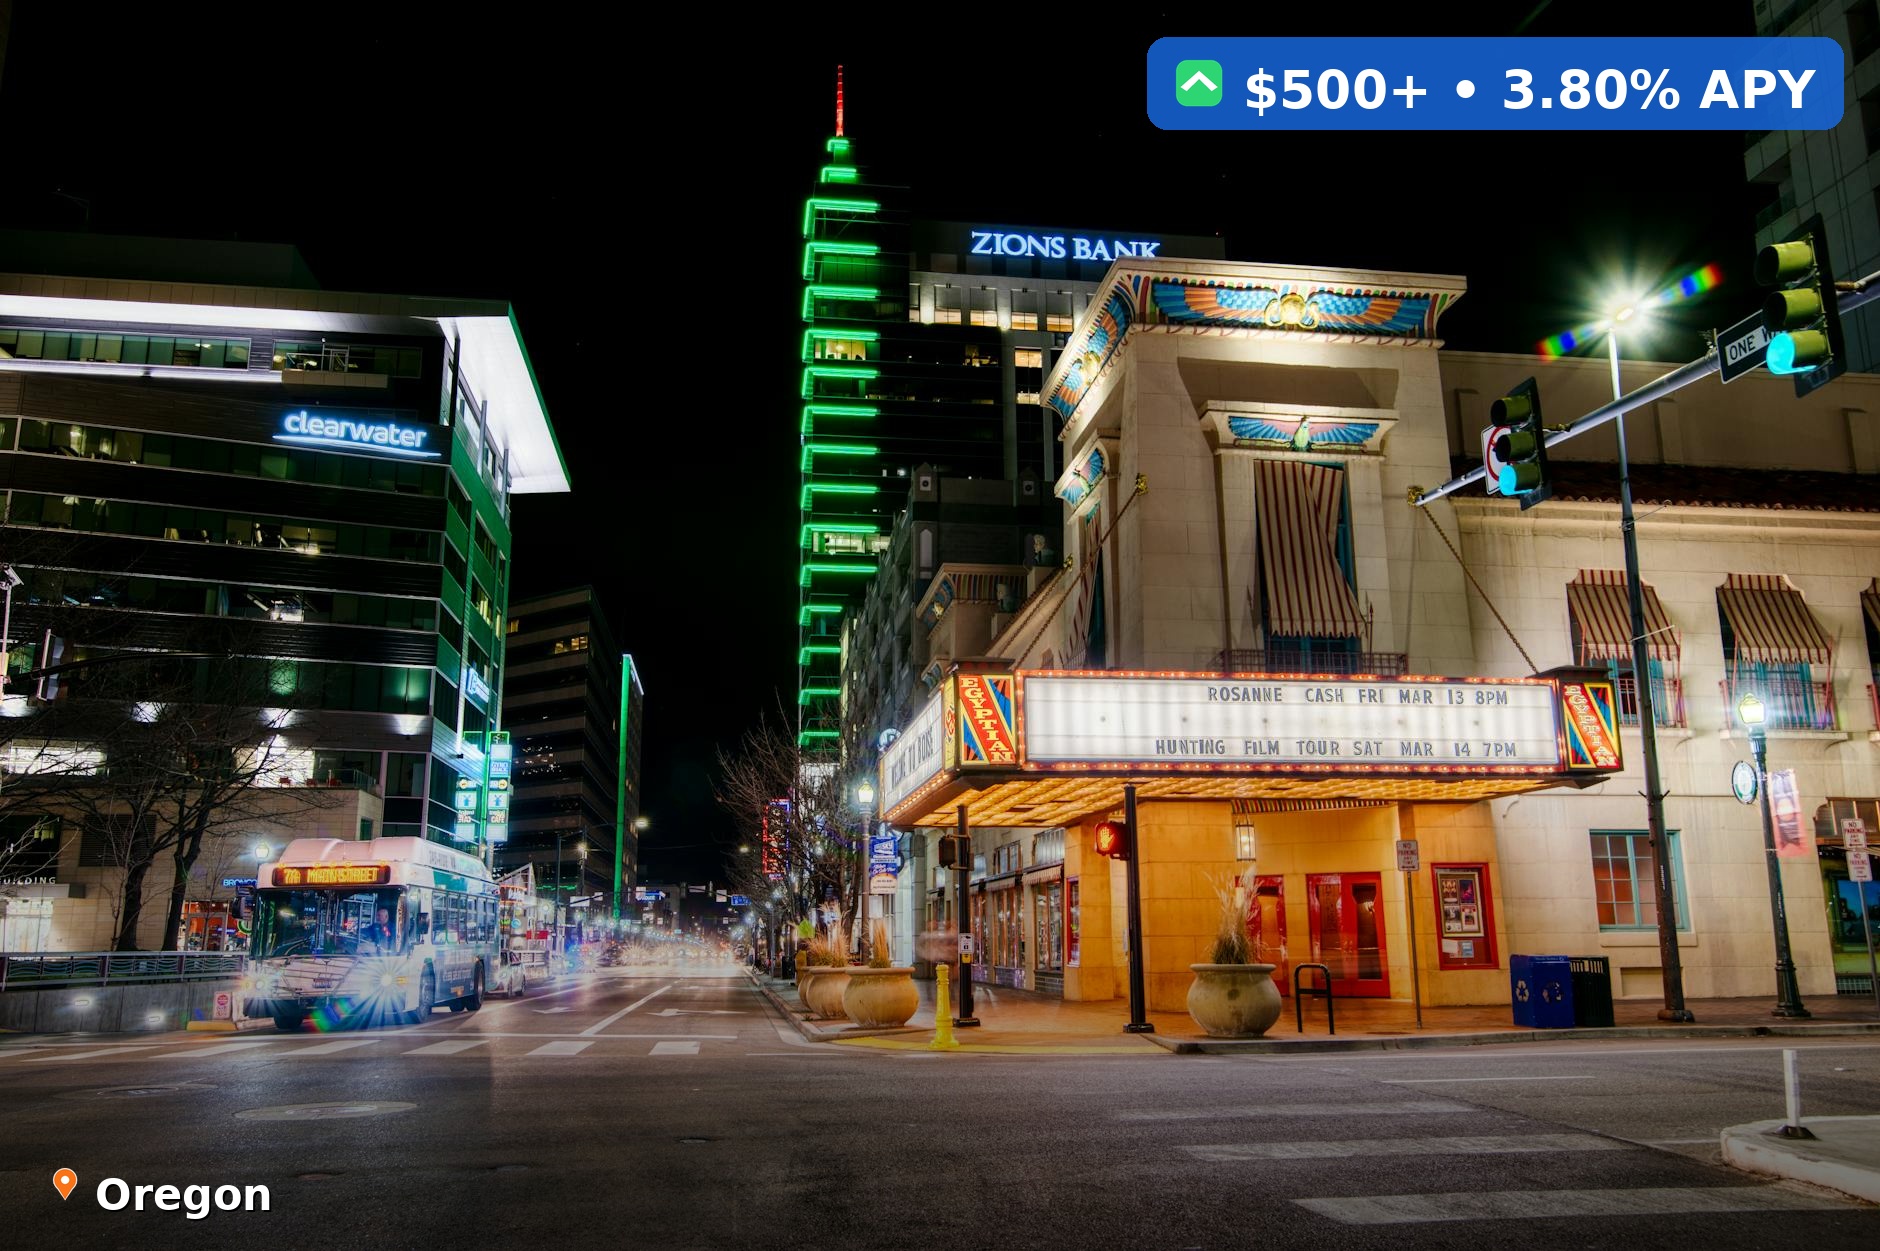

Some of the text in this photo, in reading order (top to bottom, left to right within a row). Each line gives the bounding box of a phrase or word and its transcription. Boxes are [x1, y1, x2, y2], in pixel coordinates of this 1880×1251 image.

[971, 231, 1160, 261] ZIONS BANK
[1729, 333, 1756, 361] ONE
[284, 410, 427, 447] clearwater
[1208, 686, 1508, 705] ROSANNE CASH FRI MAR 13 8PM
[960, 677, 1014, 762] EGYPTIAN
[1563, 685, 1618, 766] EGYPTIAN
[1155, 739, 1517, 757] HUNTING FILM TOUR SAT MAR 14 7PM
[0, 876, 56, 885] UILDING
